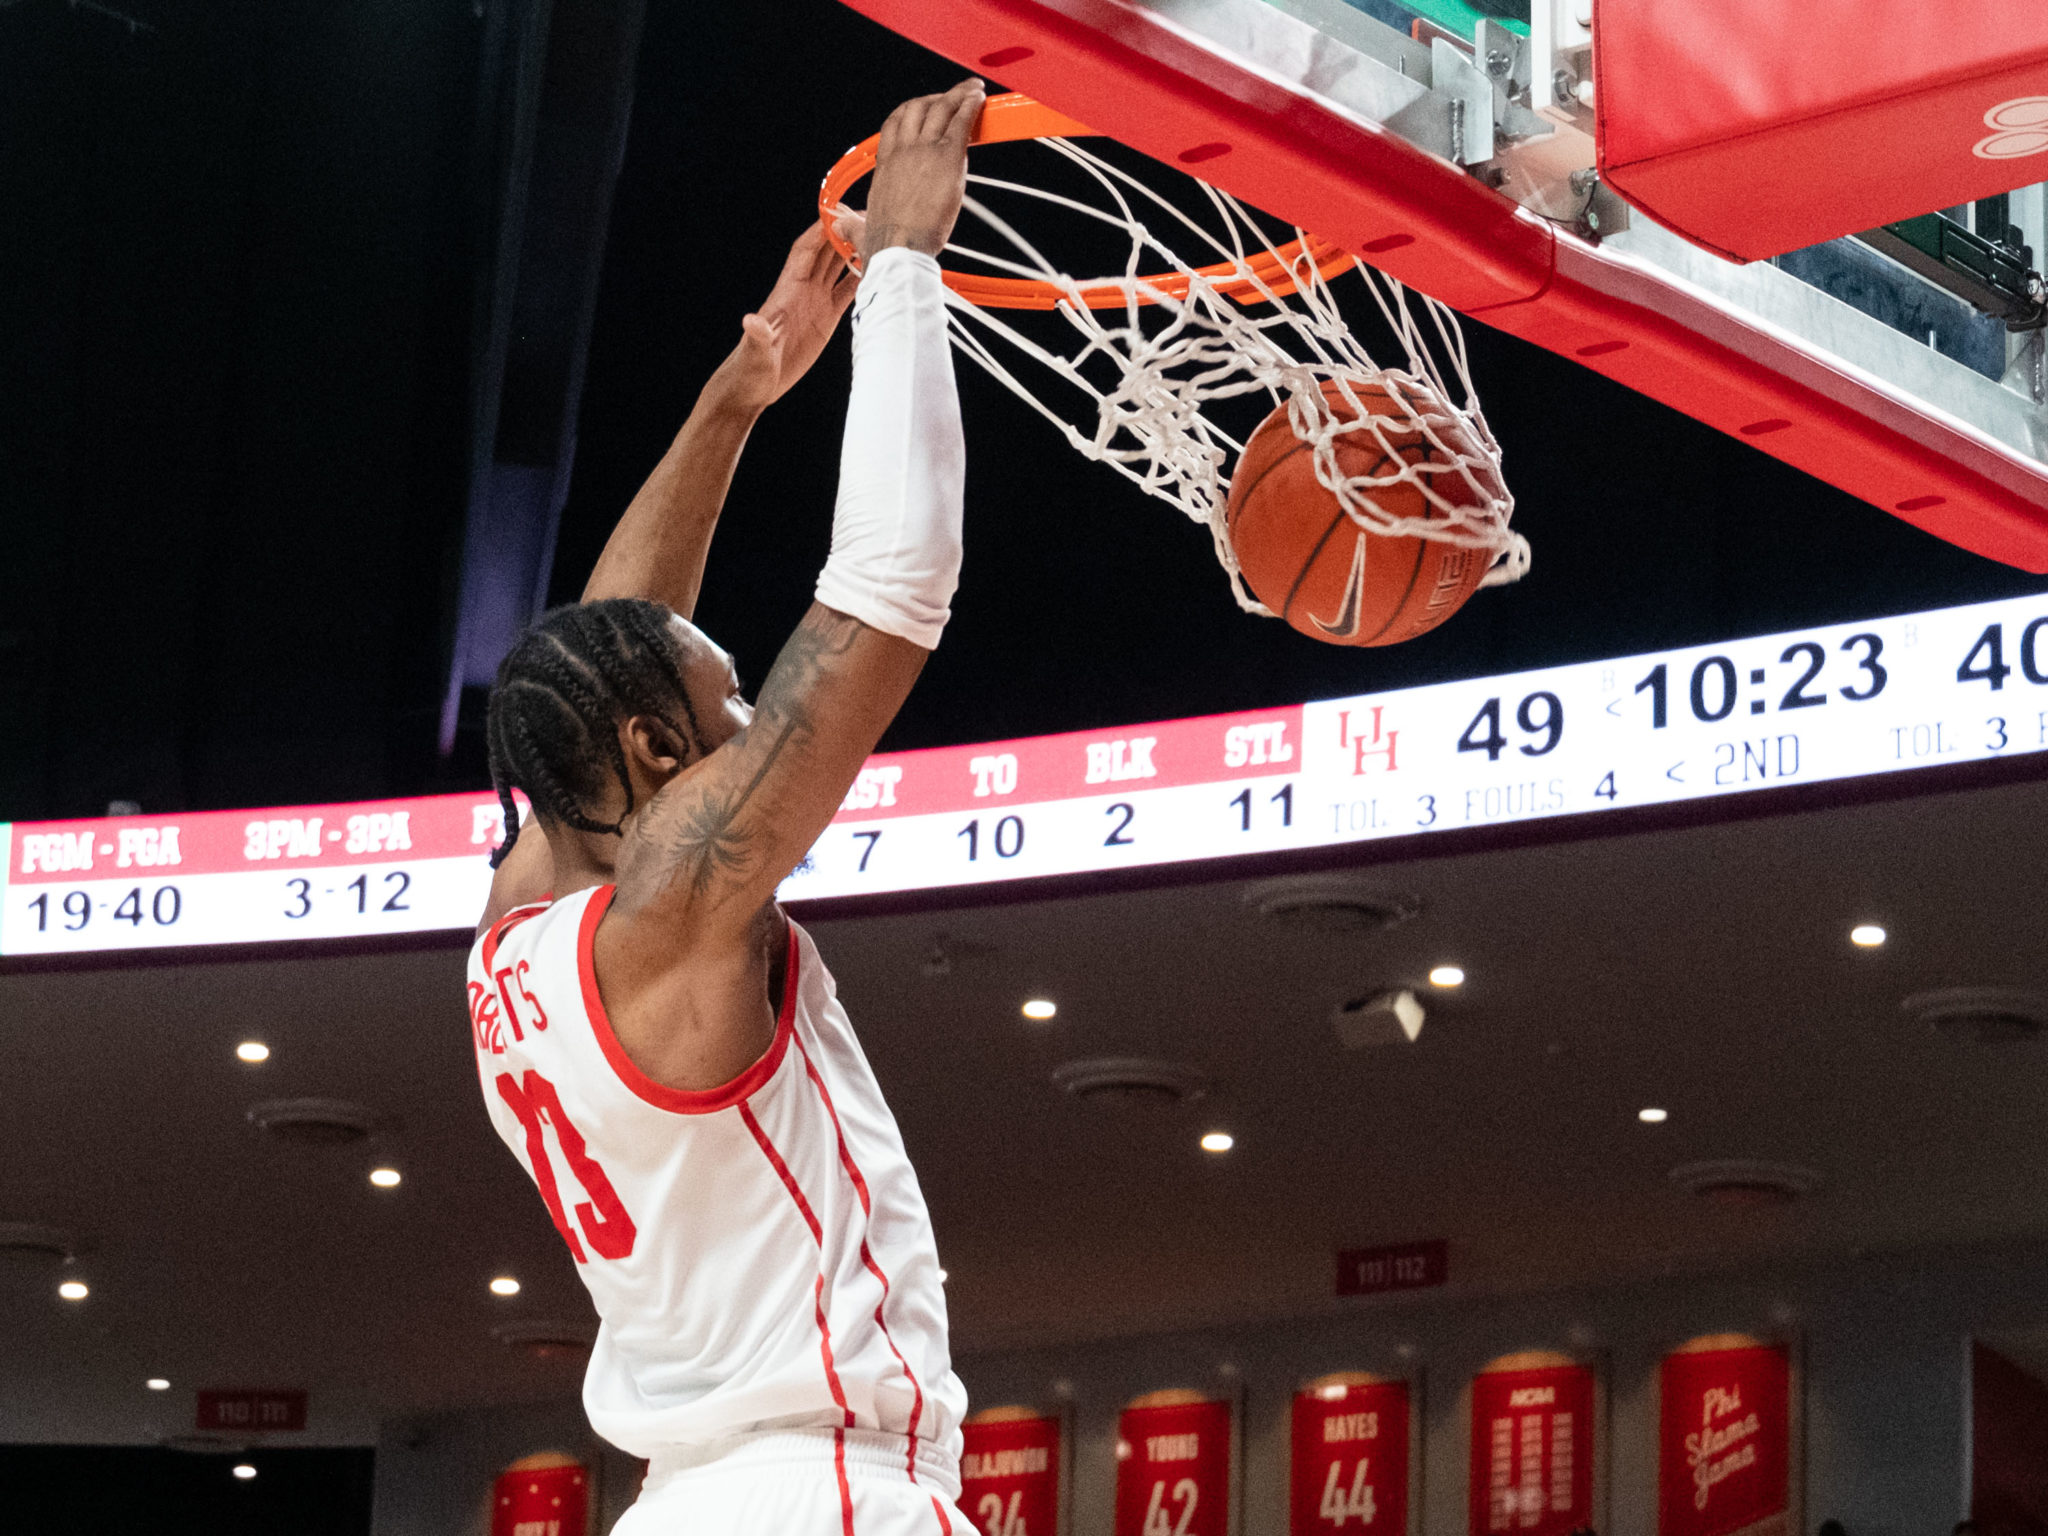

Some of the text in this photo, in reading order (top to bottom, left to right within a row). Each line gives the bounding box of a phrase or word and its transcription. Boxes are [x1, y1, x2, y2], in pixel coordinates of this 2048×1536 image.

[1634, 632, 1888, 729] 10:23
[1956, 616, 2048, 691] 40
[1457, 691, 1564, 761] 49
[1985, 717, 2008, 751] 3
[971, 753, 1018, 797] TO
[1086, 737, 1157, 785] BLK
[1224, 721, 1292, 768] STL
[1714, 734, 1800, 786] 2ND
[853, 783, 1294, 873] 7 10 2 11
[1417, 795, 1437, 826] 3
[1465, 778, 1564, 820] FOULS
[1594, 770, 1618, 801] 4
[1323, 1412, 1378, 1443] HAYES
[977, 1490, 1027, 1536] 34
[1143, 1478, 1199, 1536] 42
[1319, 1458, 1376, 1527] 44
